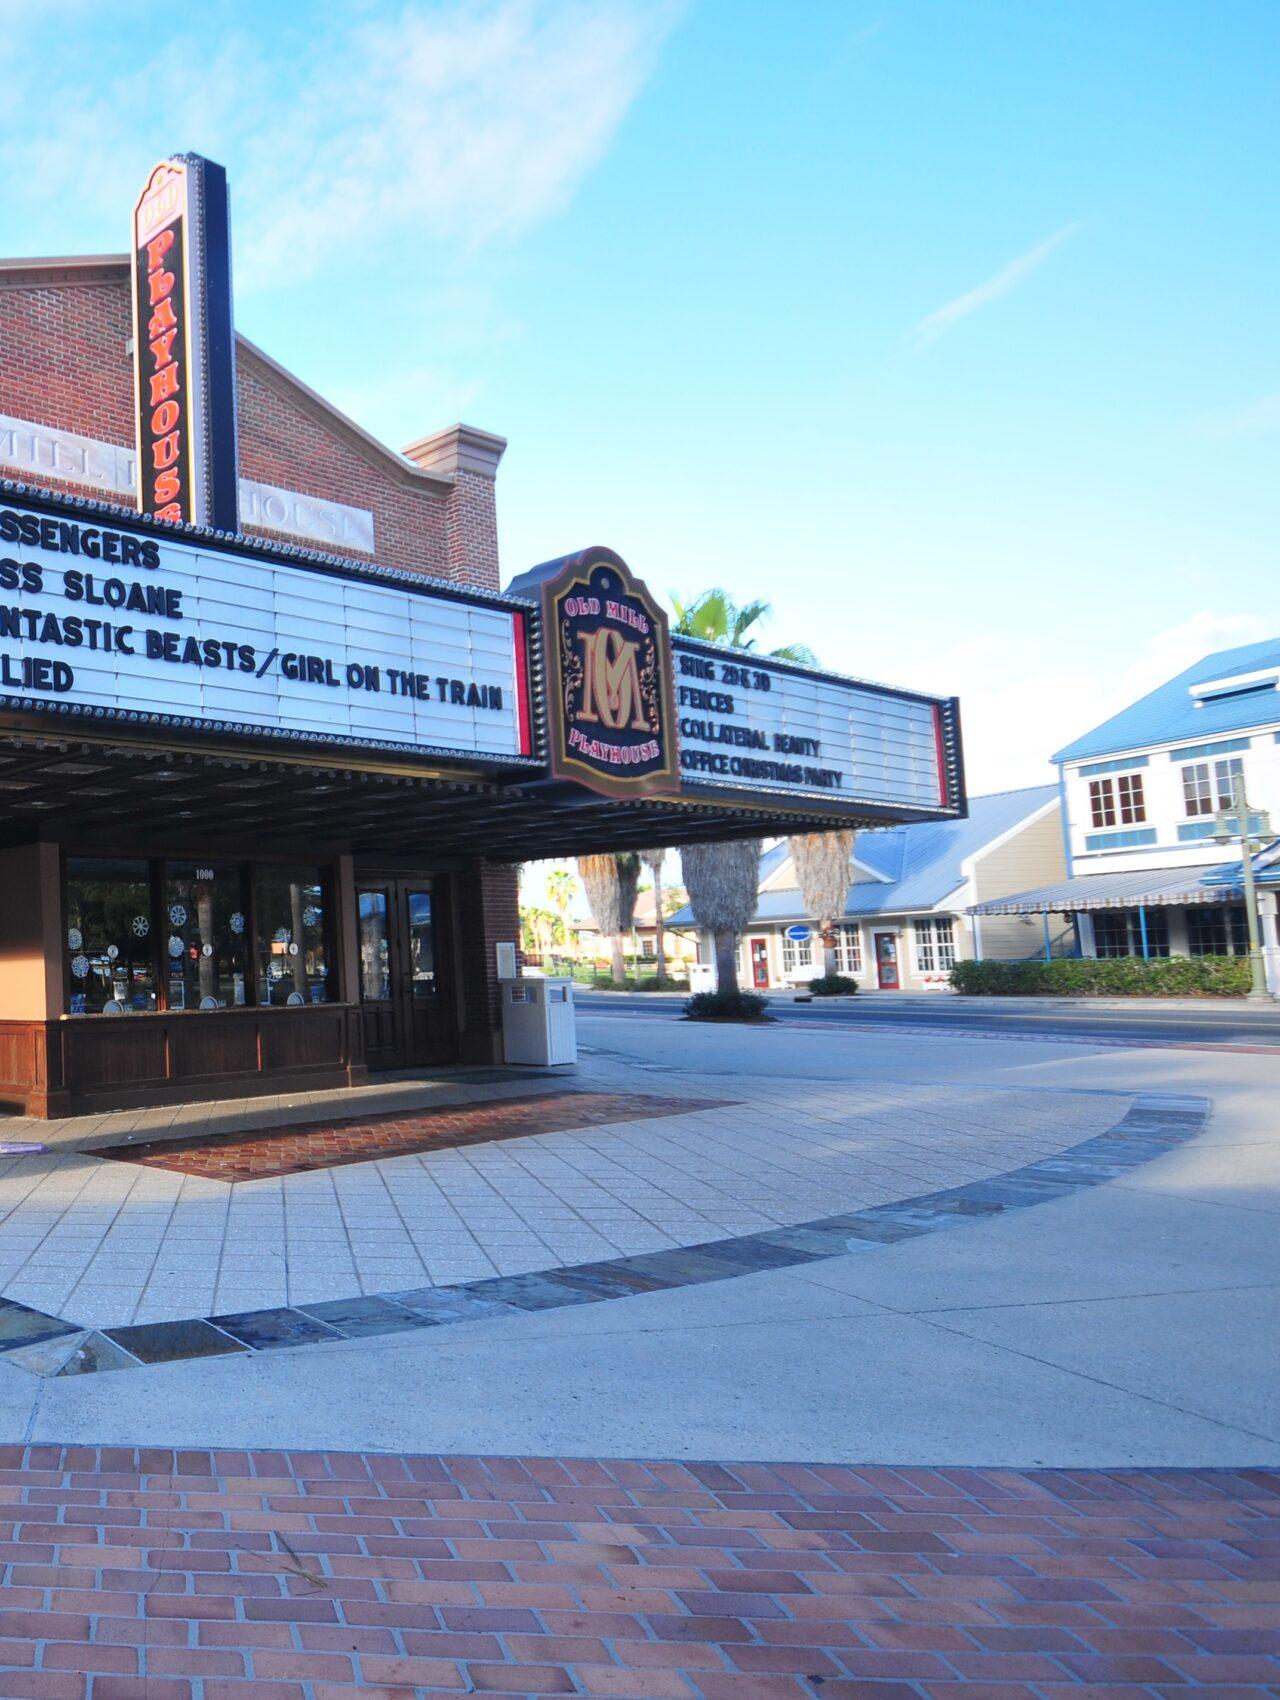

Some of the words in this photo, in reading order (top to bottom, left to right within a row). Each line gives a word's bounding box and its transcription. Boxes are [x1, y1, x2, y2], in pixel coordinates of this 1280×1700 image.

[64, 570, 183, 619] SLOANE
[565, 597, 601, 617] OLD
[606, 601, 649, 634] MILL
[347, 663, 380, 692] ON
[387, 669, 430, 700] THE
[436, 678, 503, 710] TRAIN
[680, 655, 715, 680] SING
[680, 686, 734, 714] FENCES
[569, 728, 659, 765] PLAYHOUSE
[681, 717, 770, 750] COLLATERAL
[774, 733, 820, 757] BEAUTY
[681, 749, 730, 774] OFFICE
[731, 757, 803, 783] CHRISTMAS
[805, 766, 843, 788] PARTY
